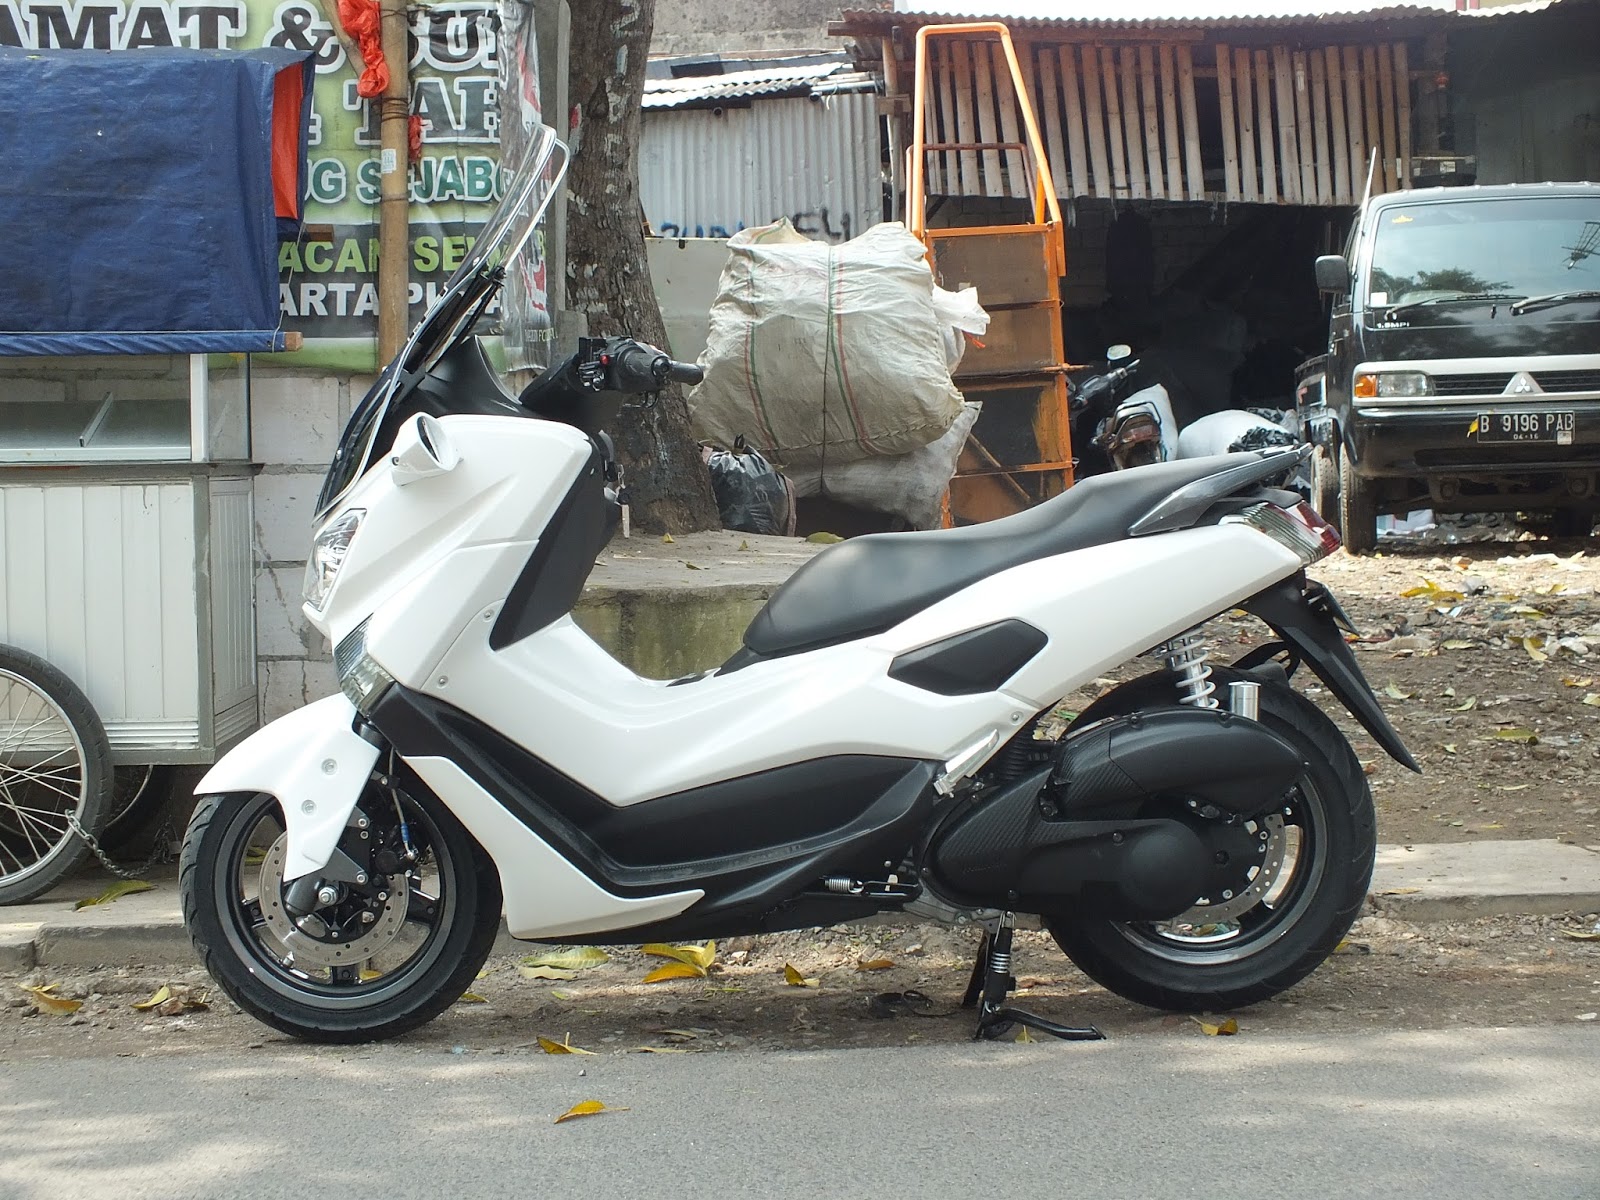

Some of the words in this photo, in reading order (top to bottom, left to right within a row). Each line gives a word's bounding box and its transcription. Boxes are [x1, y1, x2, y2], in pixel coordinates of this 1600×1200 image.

[1480, 415, 1490, 433] B
[1502, 414, 1539, 432] 9196
[1545, 413, 1574, 431] PAB
